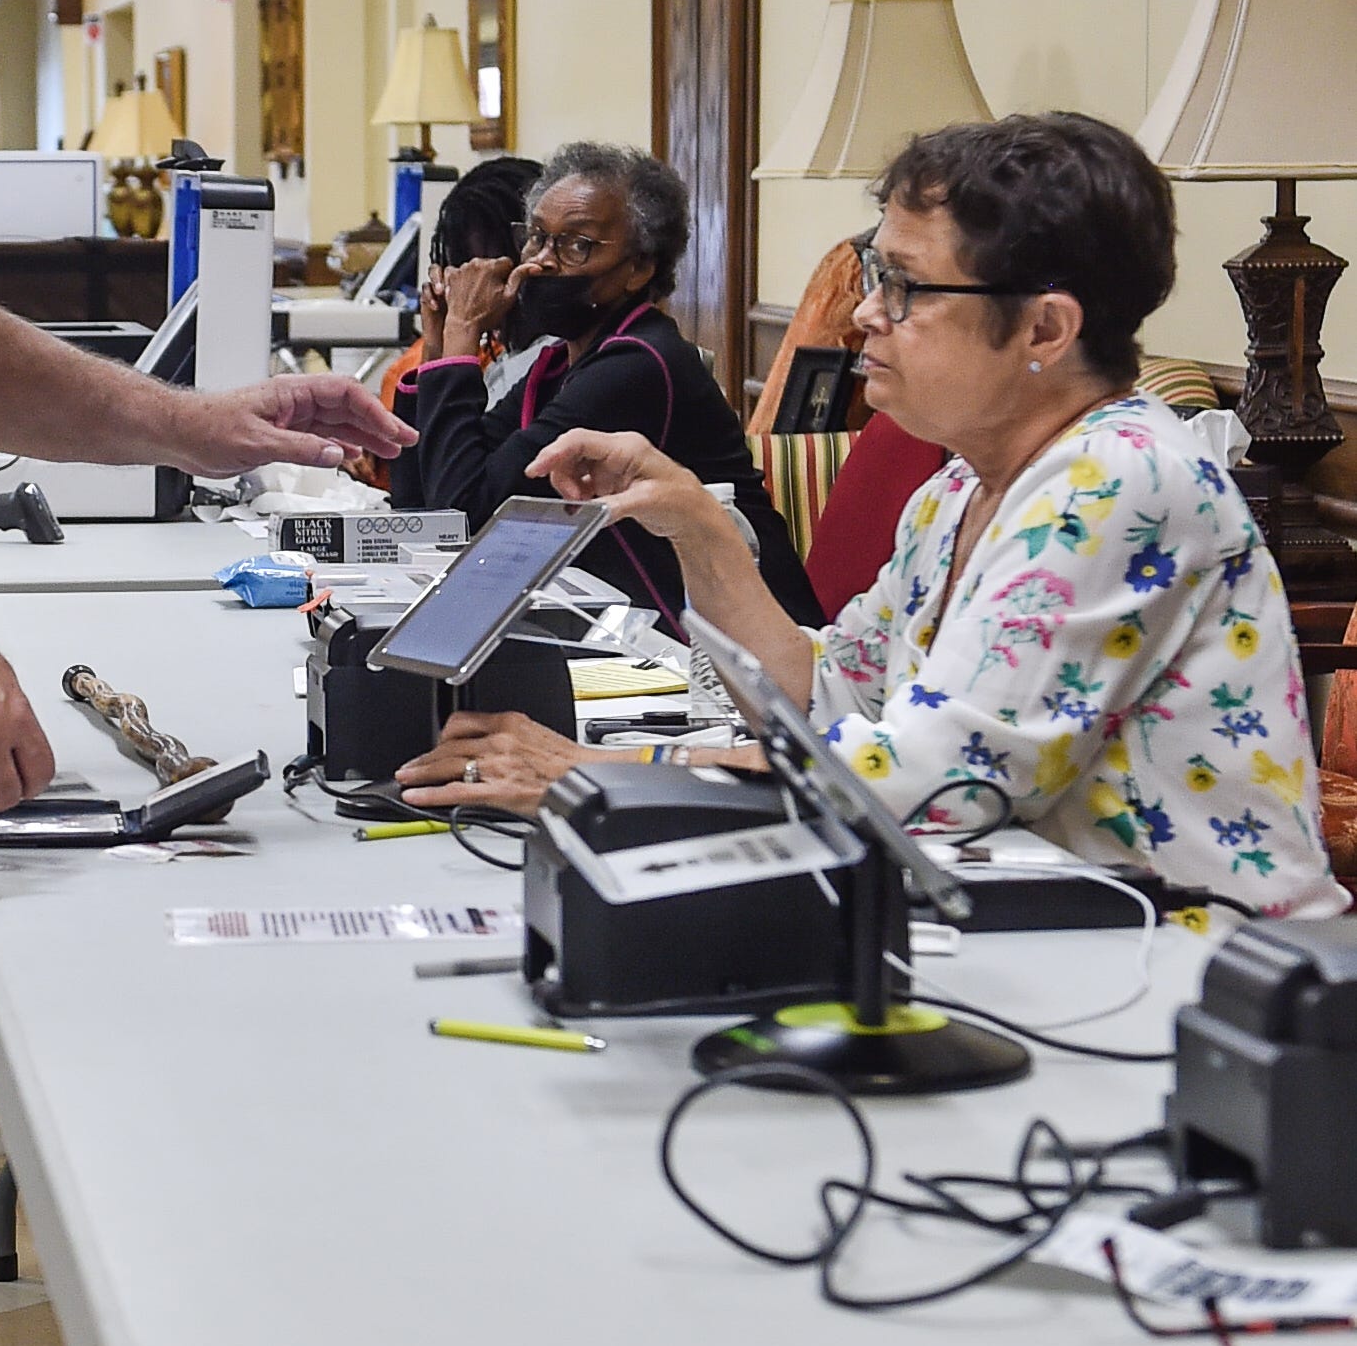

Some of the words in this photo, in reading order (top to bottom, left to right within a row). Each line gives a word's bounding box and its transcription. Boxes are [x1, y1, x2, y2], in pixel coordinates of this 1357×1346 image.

[294, 518, 332, 529] BLACK
[295, 528, 332, 536] NITRILE
[295, 536, 331, 544] GLOVES
